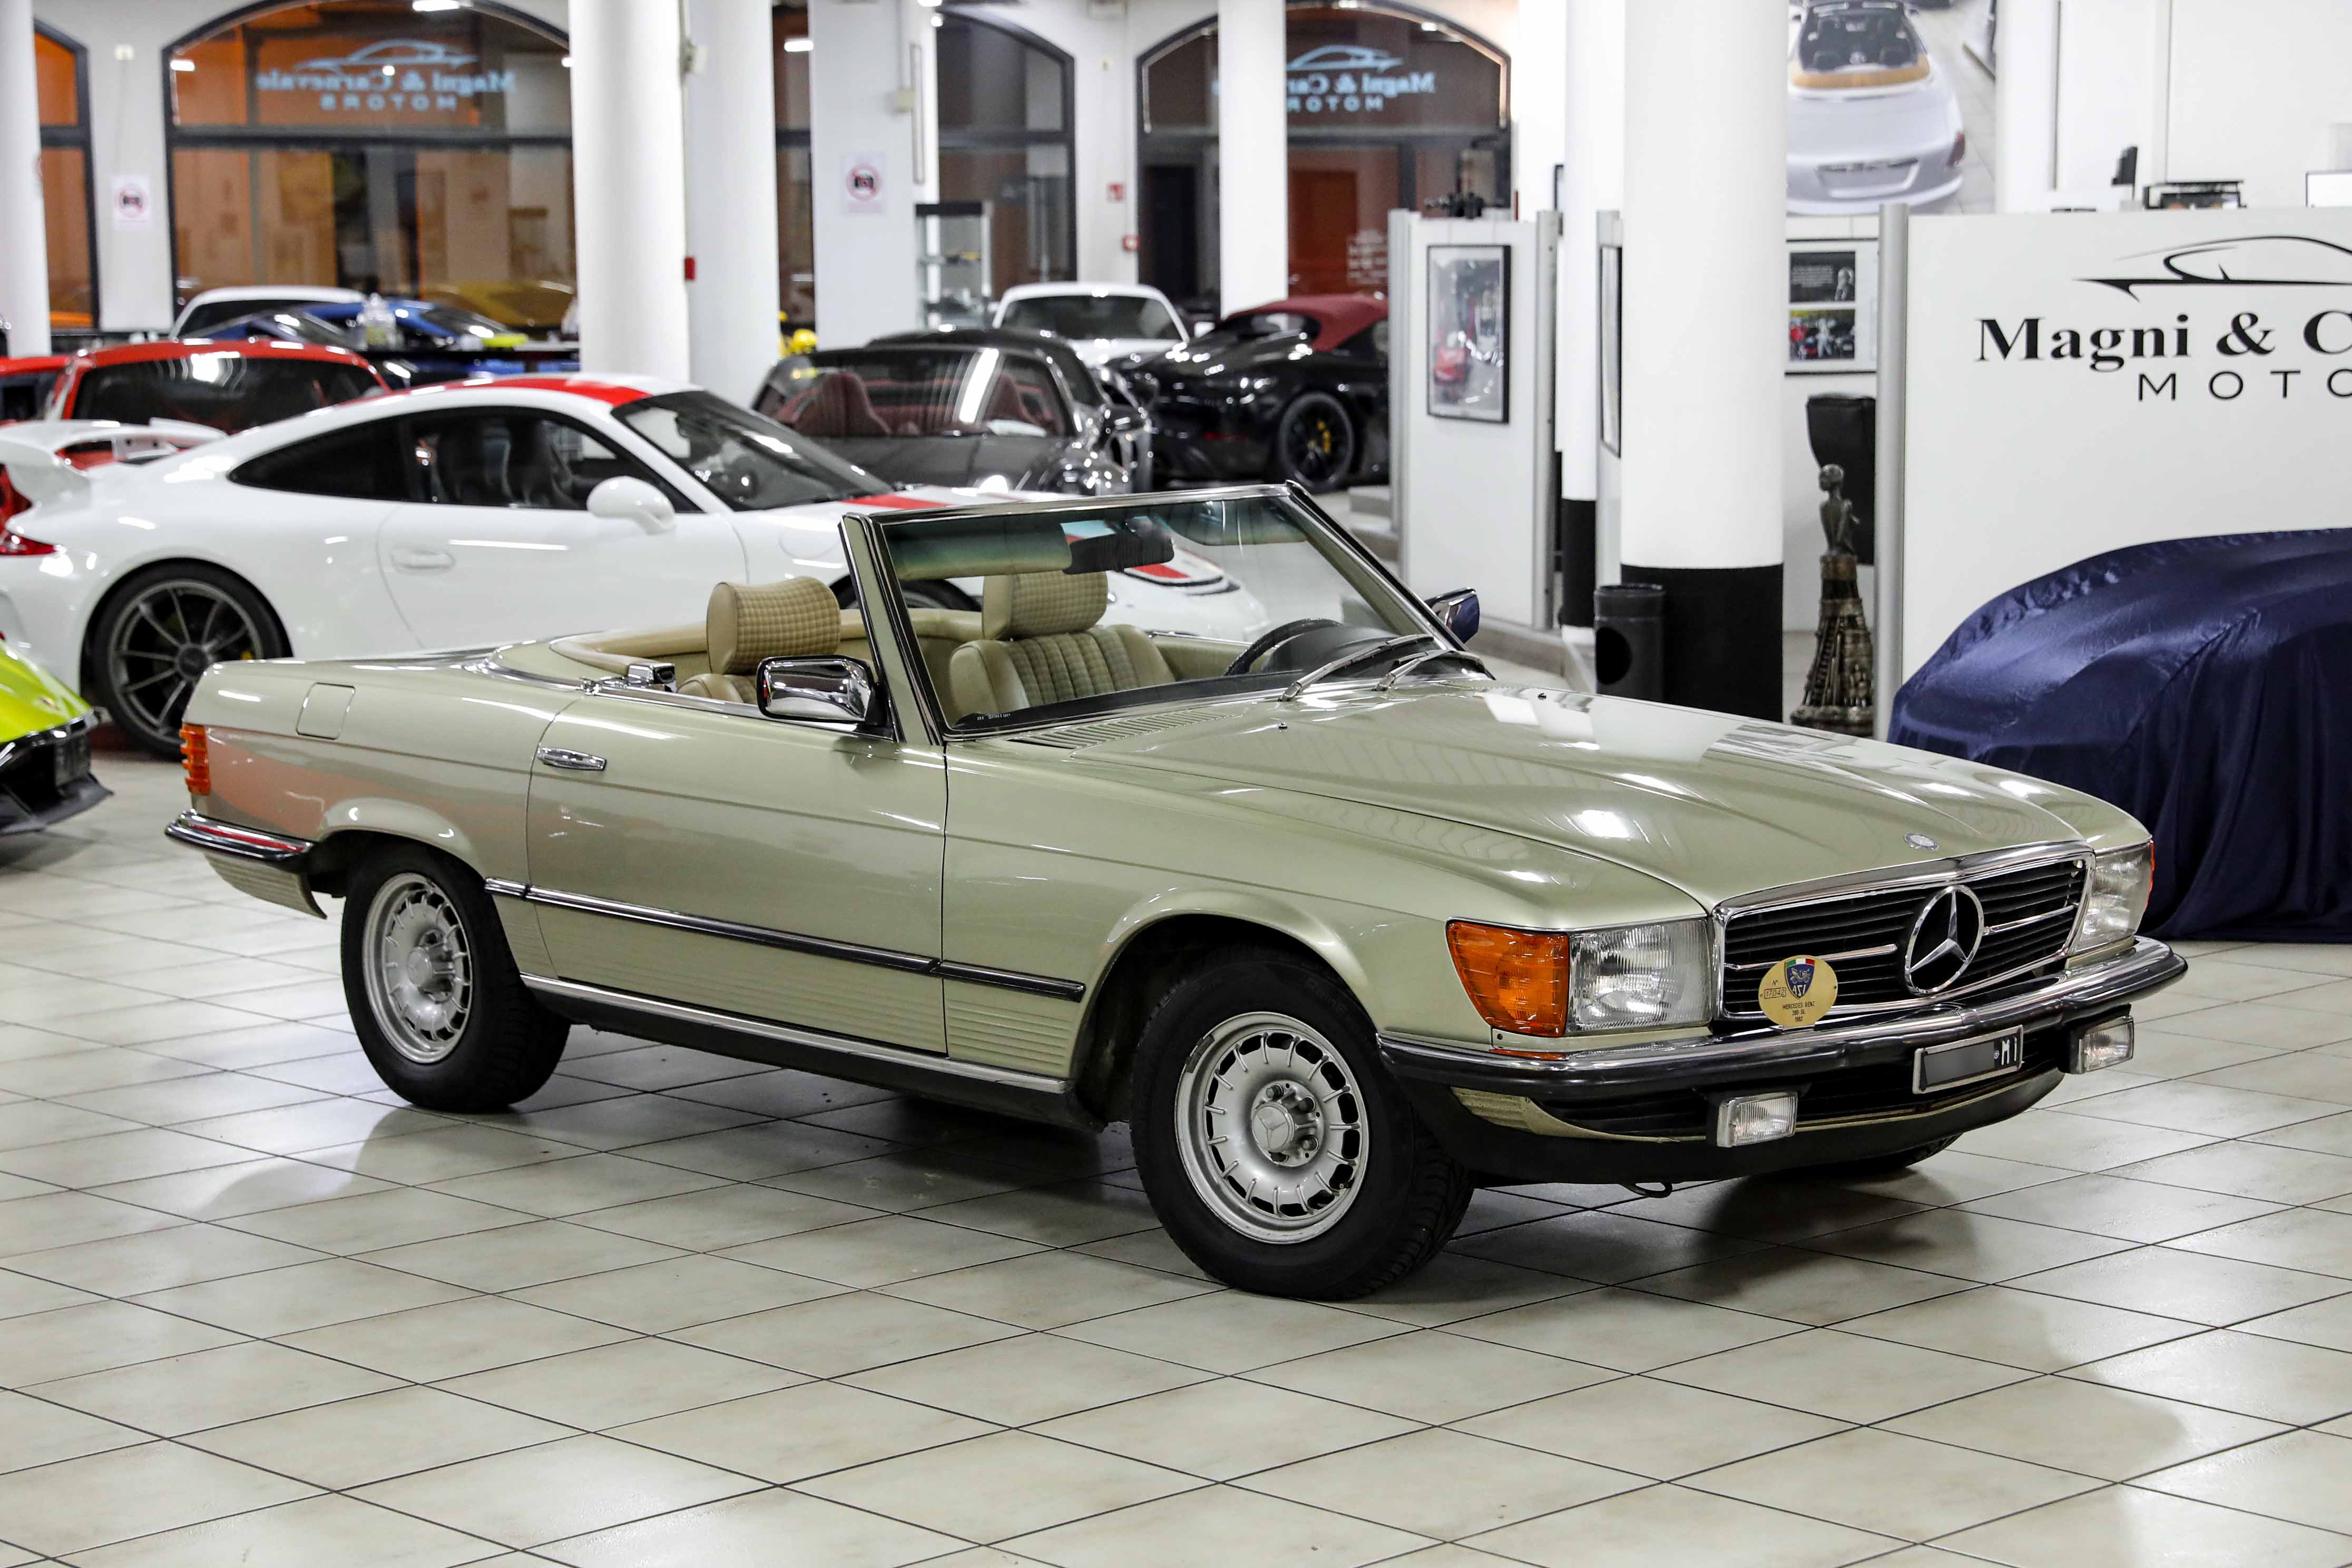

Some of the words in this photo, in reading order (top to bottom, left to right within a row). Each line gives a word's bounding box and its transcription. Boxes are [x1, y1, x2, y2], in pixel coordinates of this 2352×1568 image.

[1975, 313, 2191, 373] Magni
[2216, 312, 2276, 357] &
[1766, 989, 1785, 997] 17042
